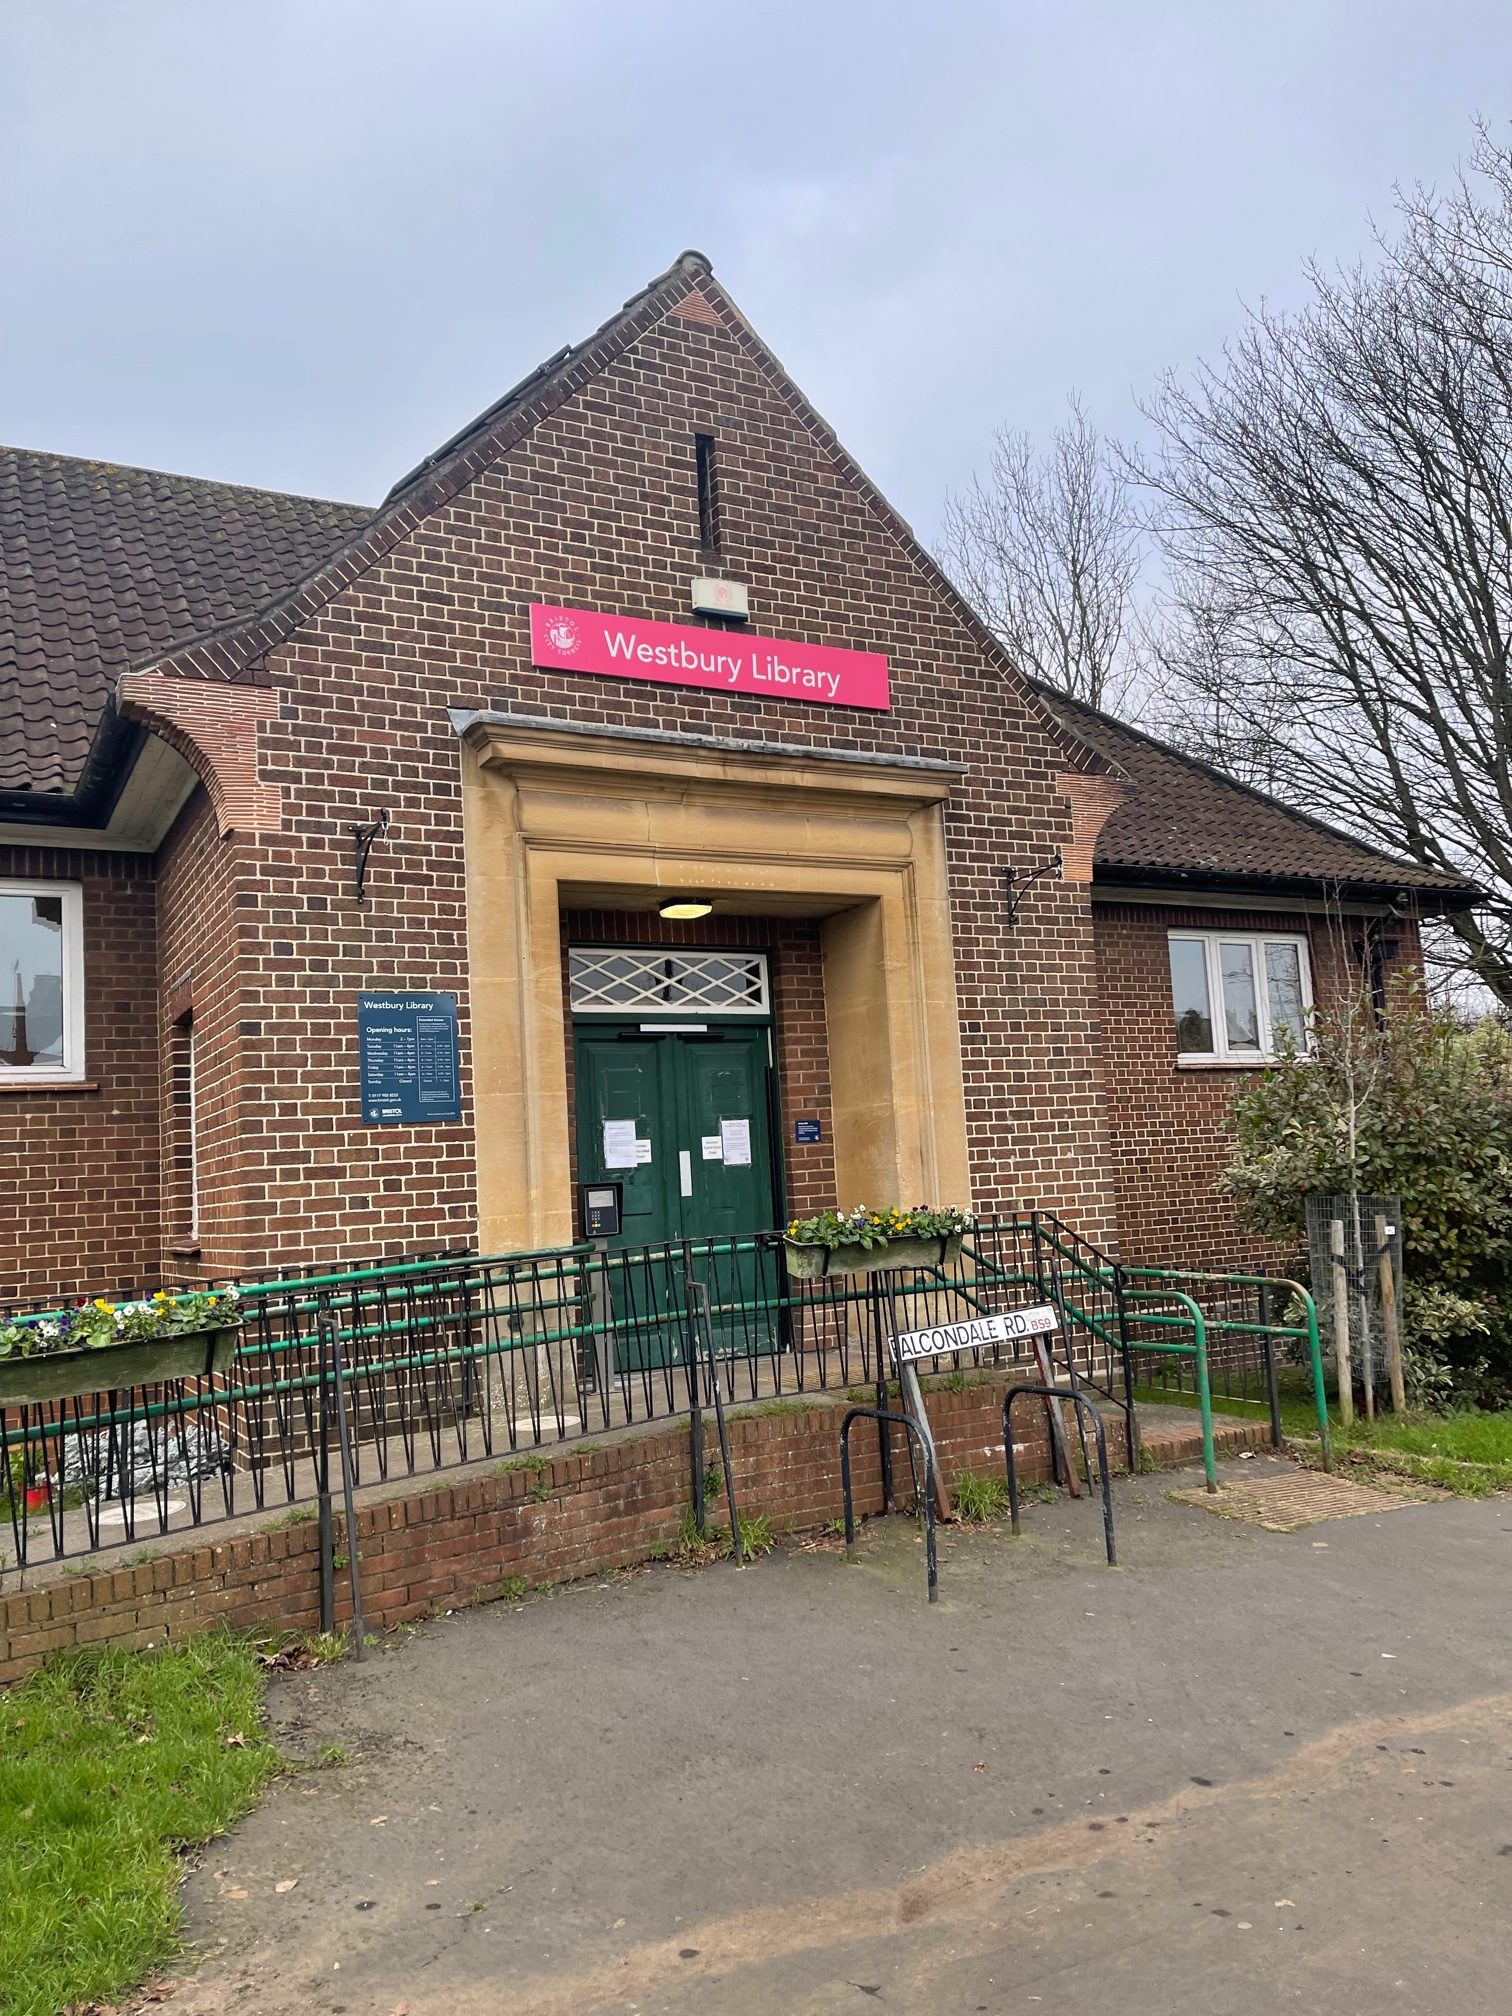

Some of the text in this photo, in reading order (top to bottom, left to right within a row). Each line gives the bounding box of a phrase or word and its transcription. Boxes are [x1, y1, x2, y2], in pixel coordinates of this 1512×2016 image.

[604, 629, 841, 697] Westbury Library
[364, 1001, 434, 1011] Westbury Library
[366, 1026, 393, 1034] Opening
[1004, 1314, 1030, 1336] RD.
[1030, 1318, 1051, 1330] BS9
